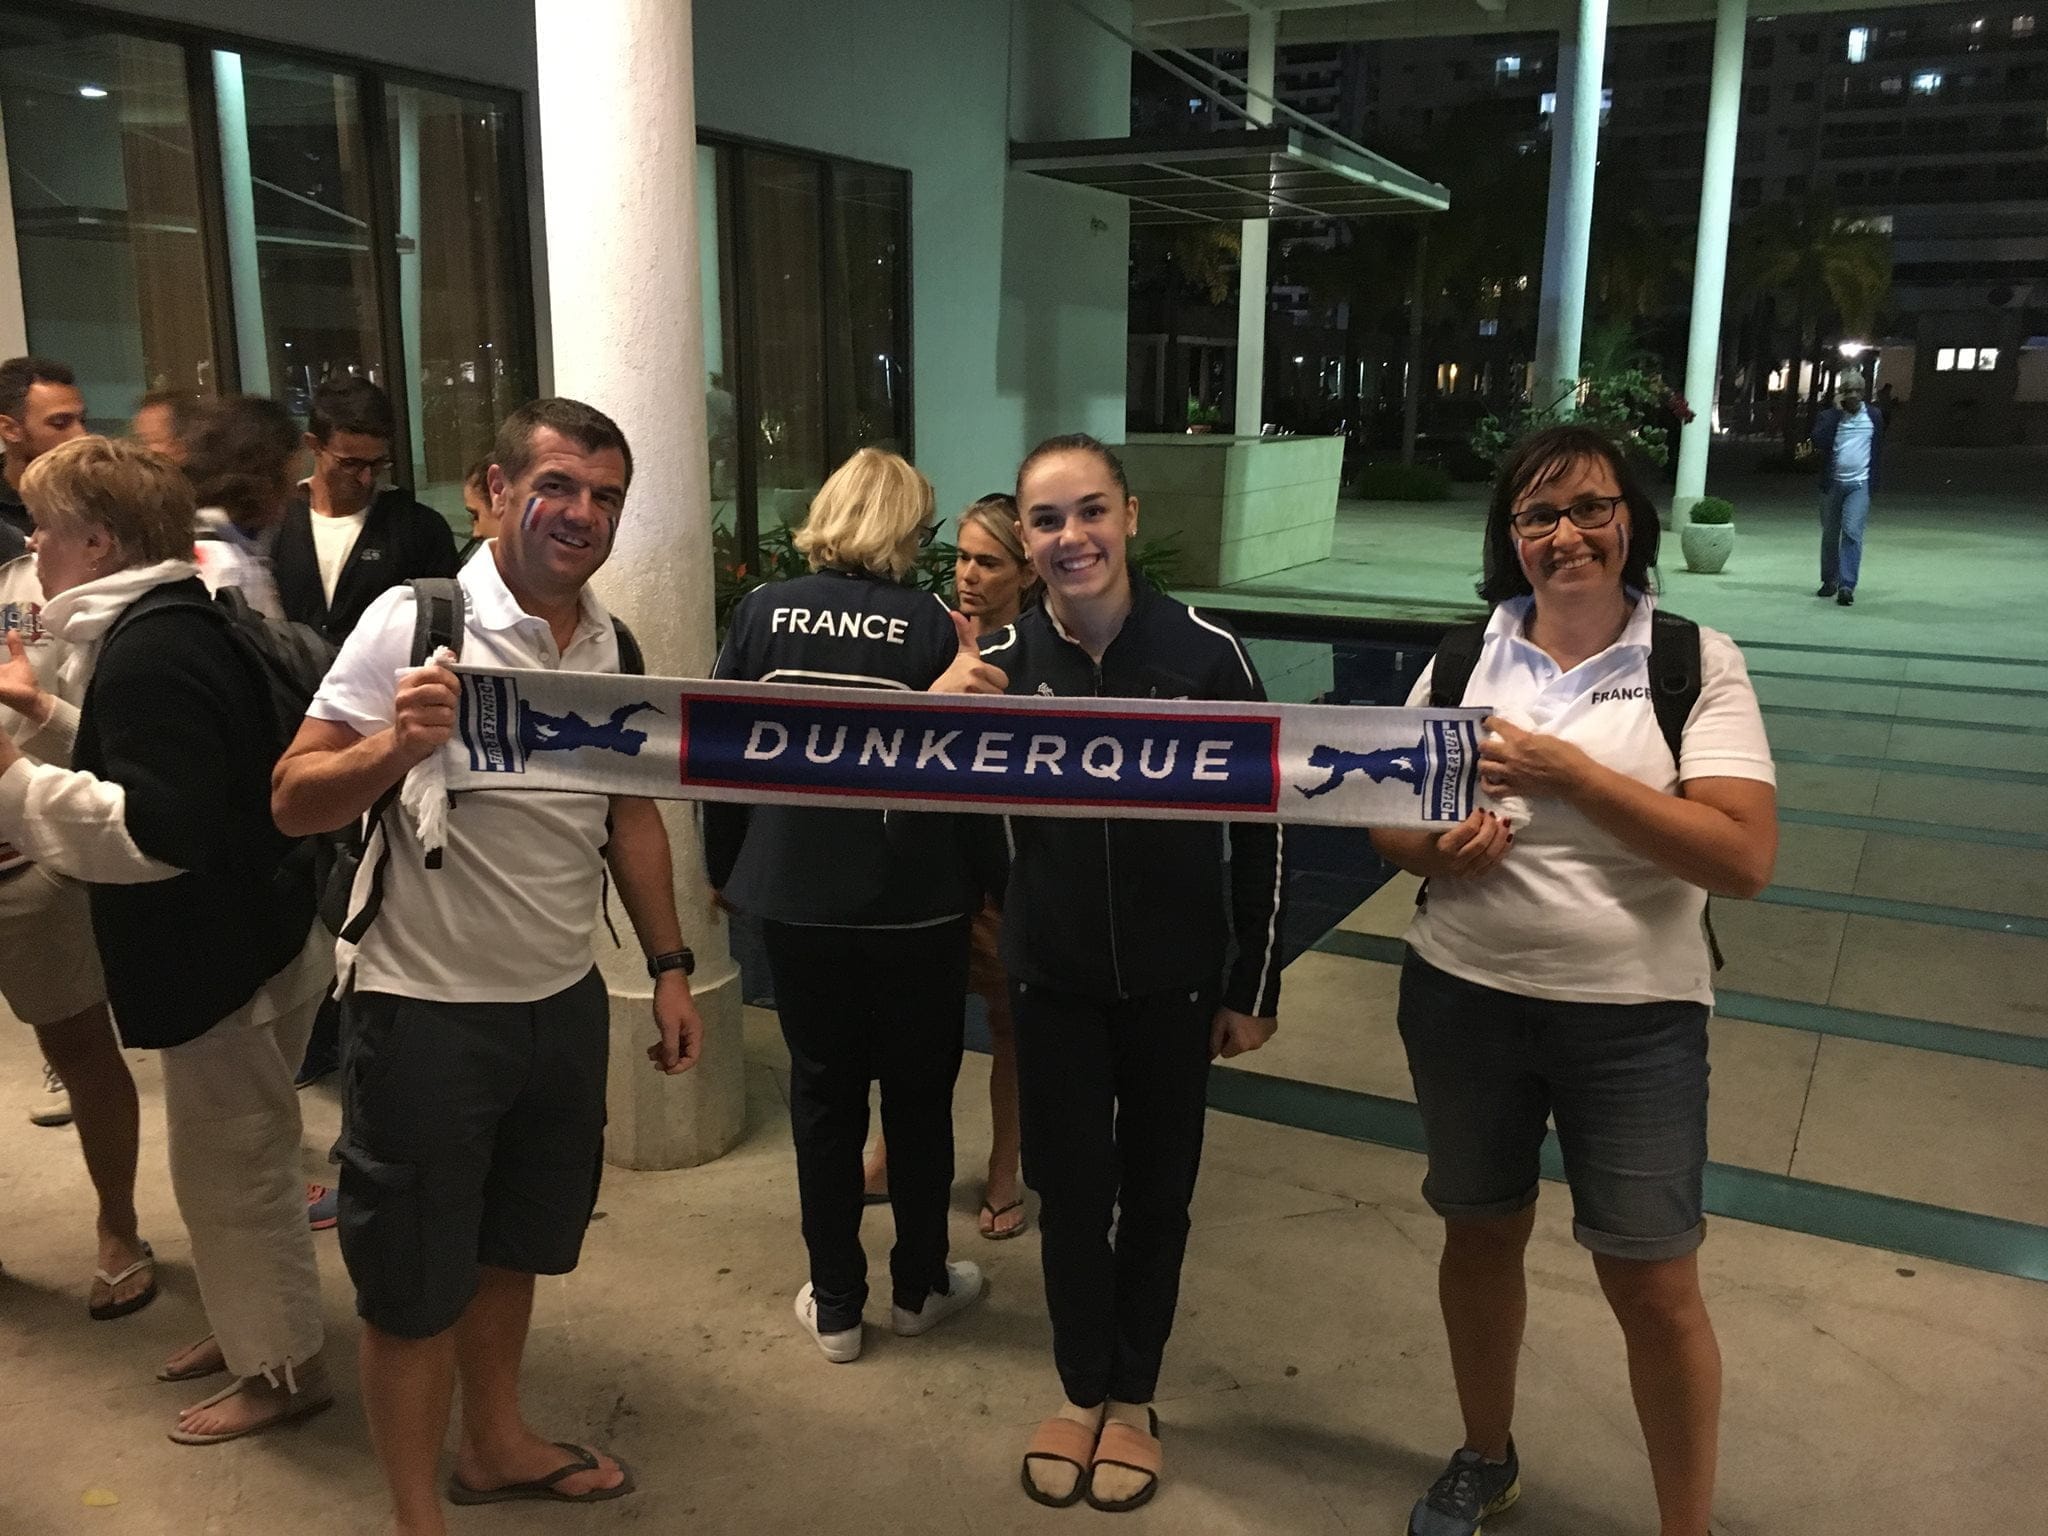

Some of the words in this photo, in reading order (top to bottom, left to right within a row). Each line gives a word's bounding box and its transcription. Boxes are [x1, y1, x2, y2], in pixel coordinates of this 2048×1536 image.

[770, 607, 909, 643] FRANCE
[482, 682, 505, 765] DUNKERQUE
[743, 719, 1236, 783] DUNKERQUE
[1441, 728, 1462, 811] DUNKERQUE
